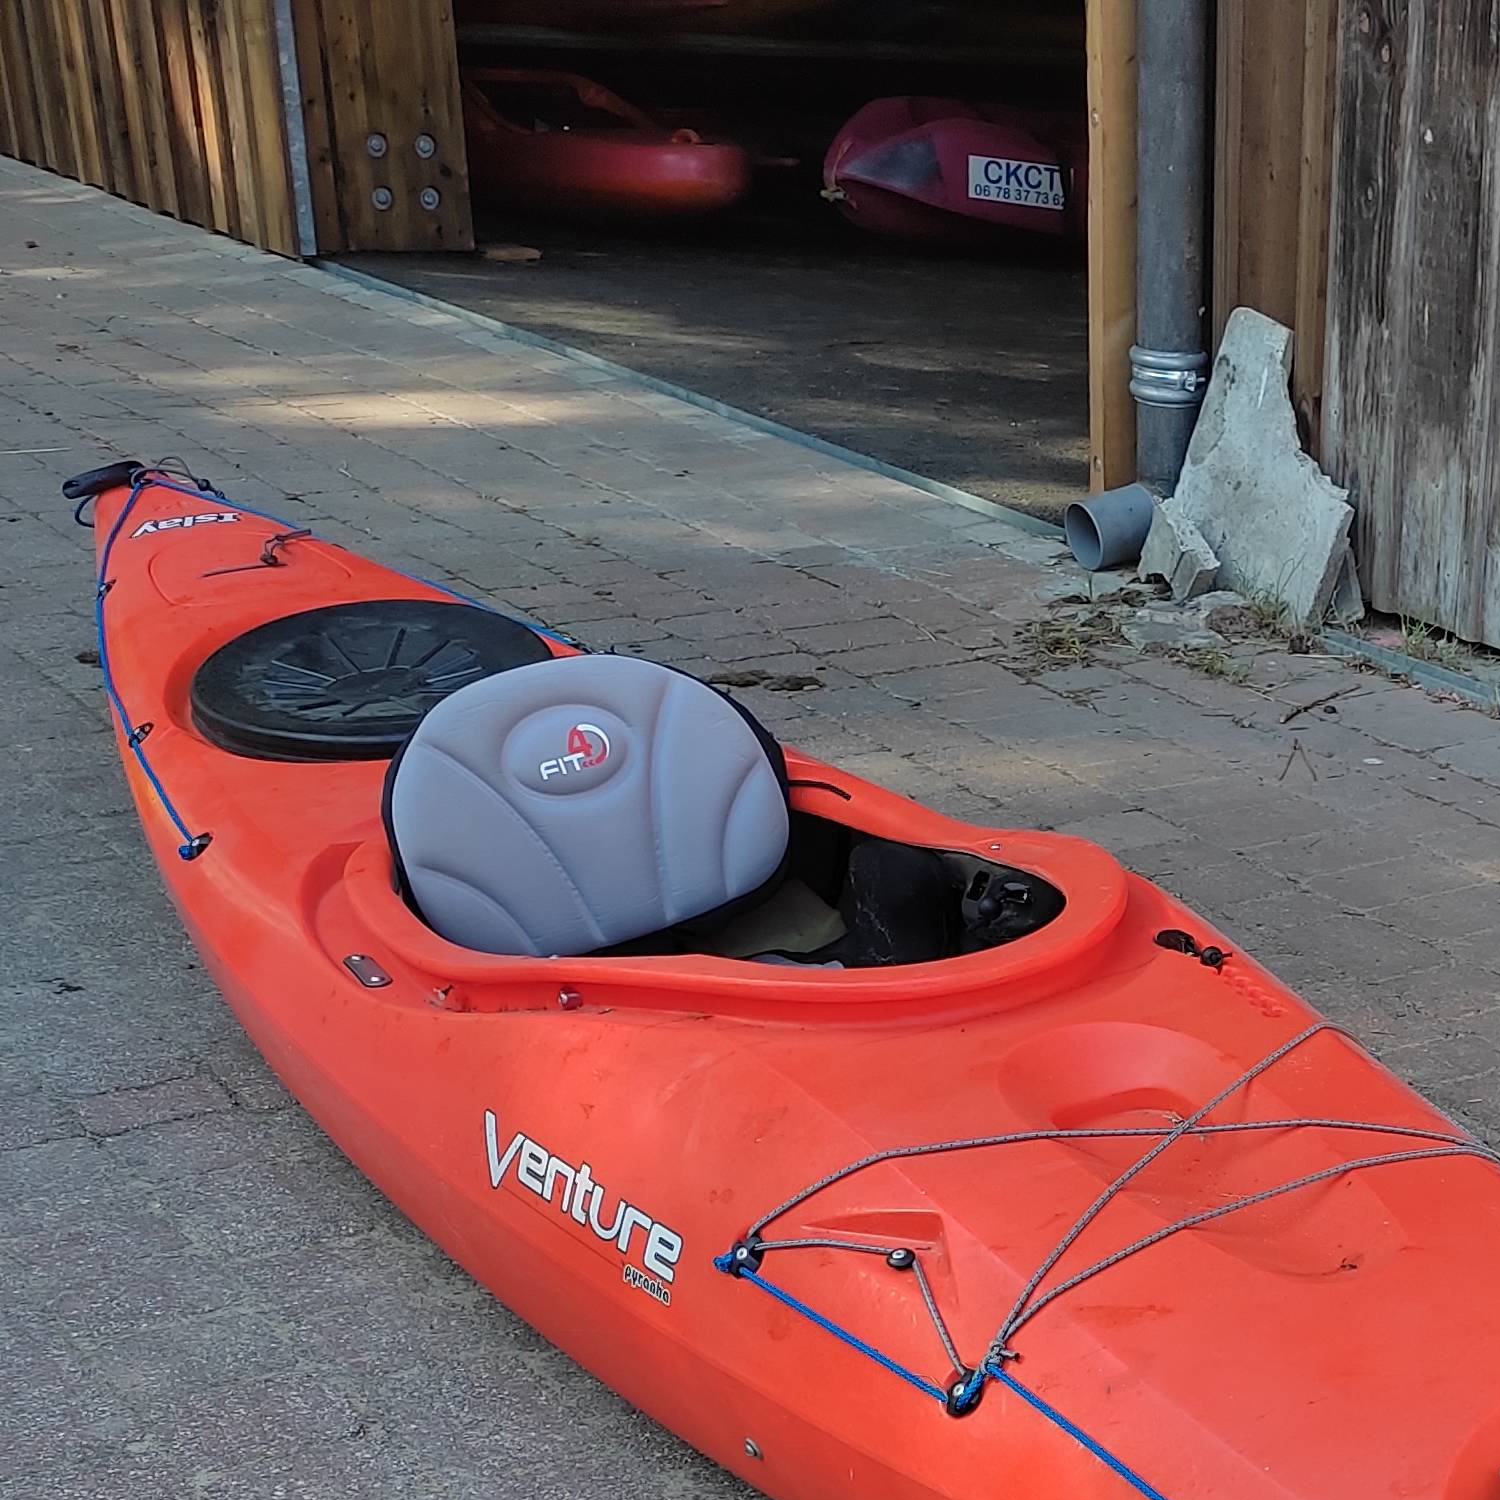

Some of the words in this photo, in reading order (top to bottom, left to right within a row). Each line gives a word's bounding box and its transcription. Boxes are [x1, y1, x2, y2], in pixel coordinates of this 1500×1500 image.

[984, 160, 1060, 192] CKCT
[974, 183, 991, 197] 06
[995, 186, 1011, 200] 78
[1014, 188, 1031, 201] 37
[1034, 190, 1049, 204] 73
[539, 752, 585, 780] FIT
[484, 1109, 683, 1284] Venture
[624, 1264, 671, 1306] pyranha
